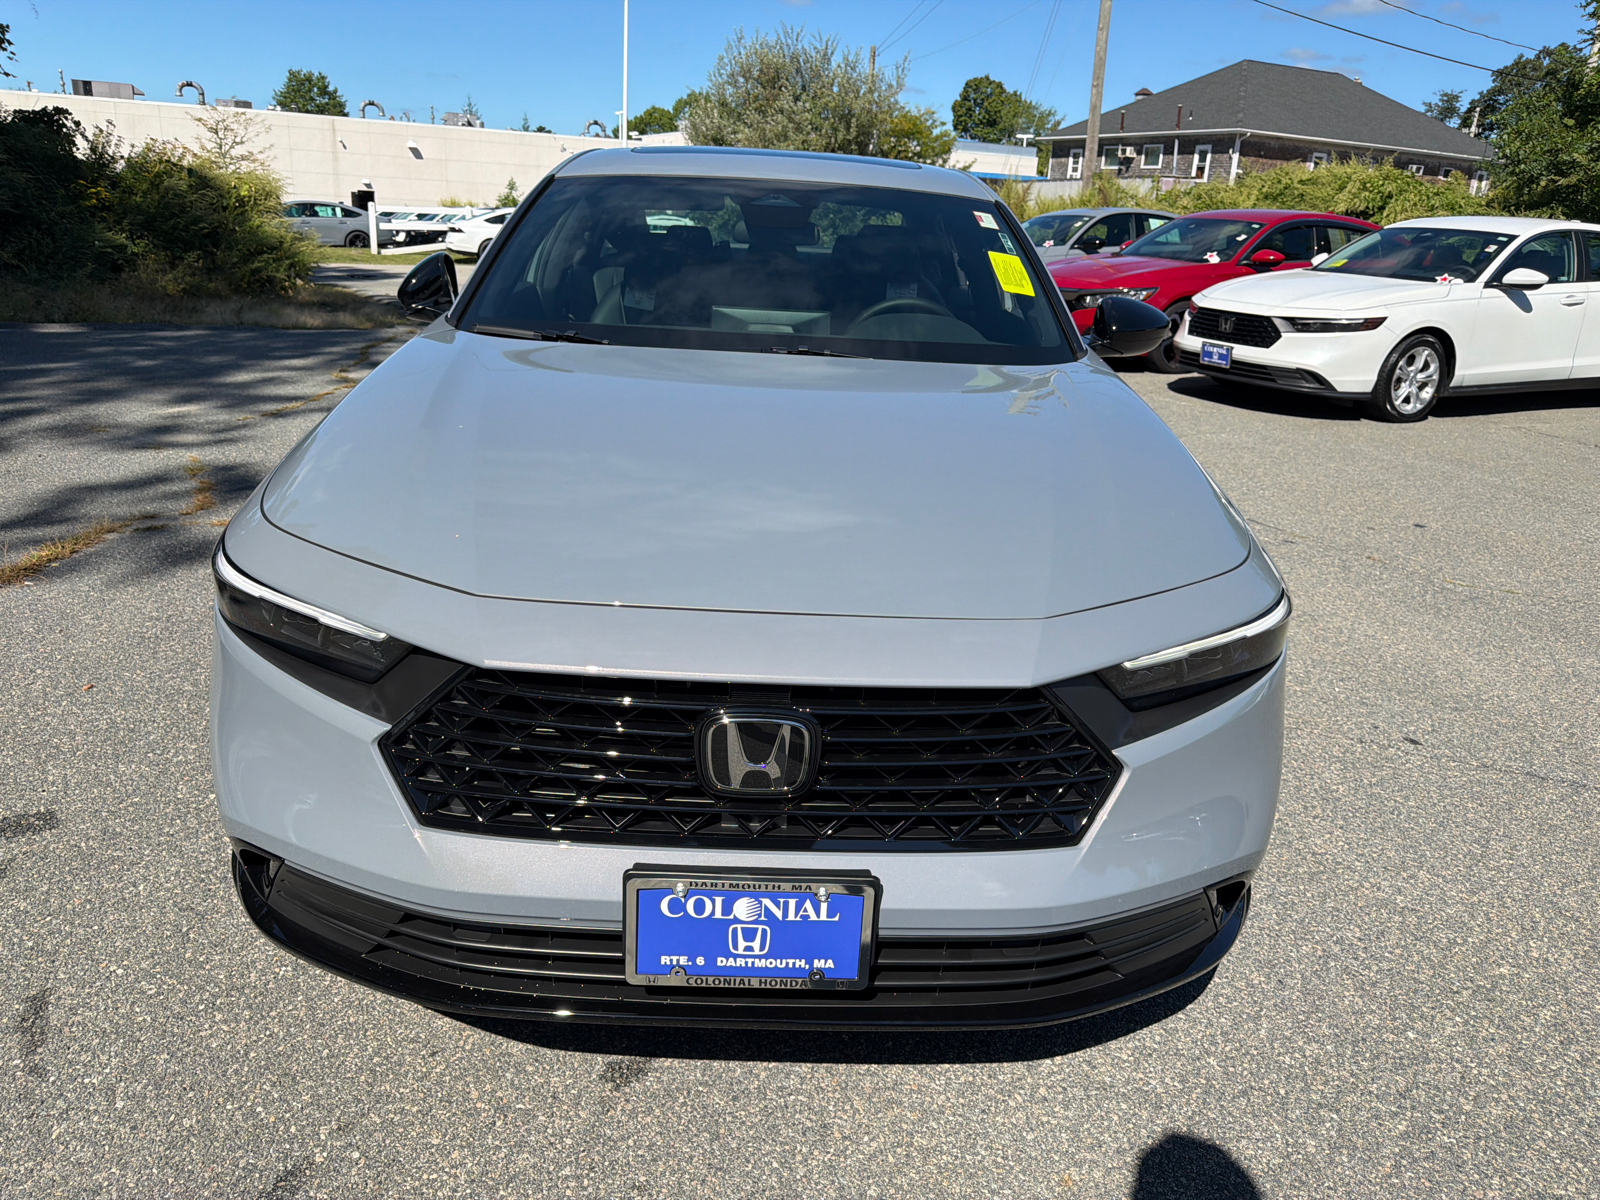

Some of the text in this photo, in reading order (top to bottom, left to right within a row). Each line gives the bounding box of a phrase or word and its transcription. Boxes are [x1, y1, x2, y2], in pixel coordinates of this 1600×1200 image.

[791, 884, 813, 892] MA
[660, 895, 840, 921] COLONIAL
[660, 955, 835, 970] RTE. 6 DARTMOUTH, MA
[686, 976, 809, 989] COLONIAL HONDA
